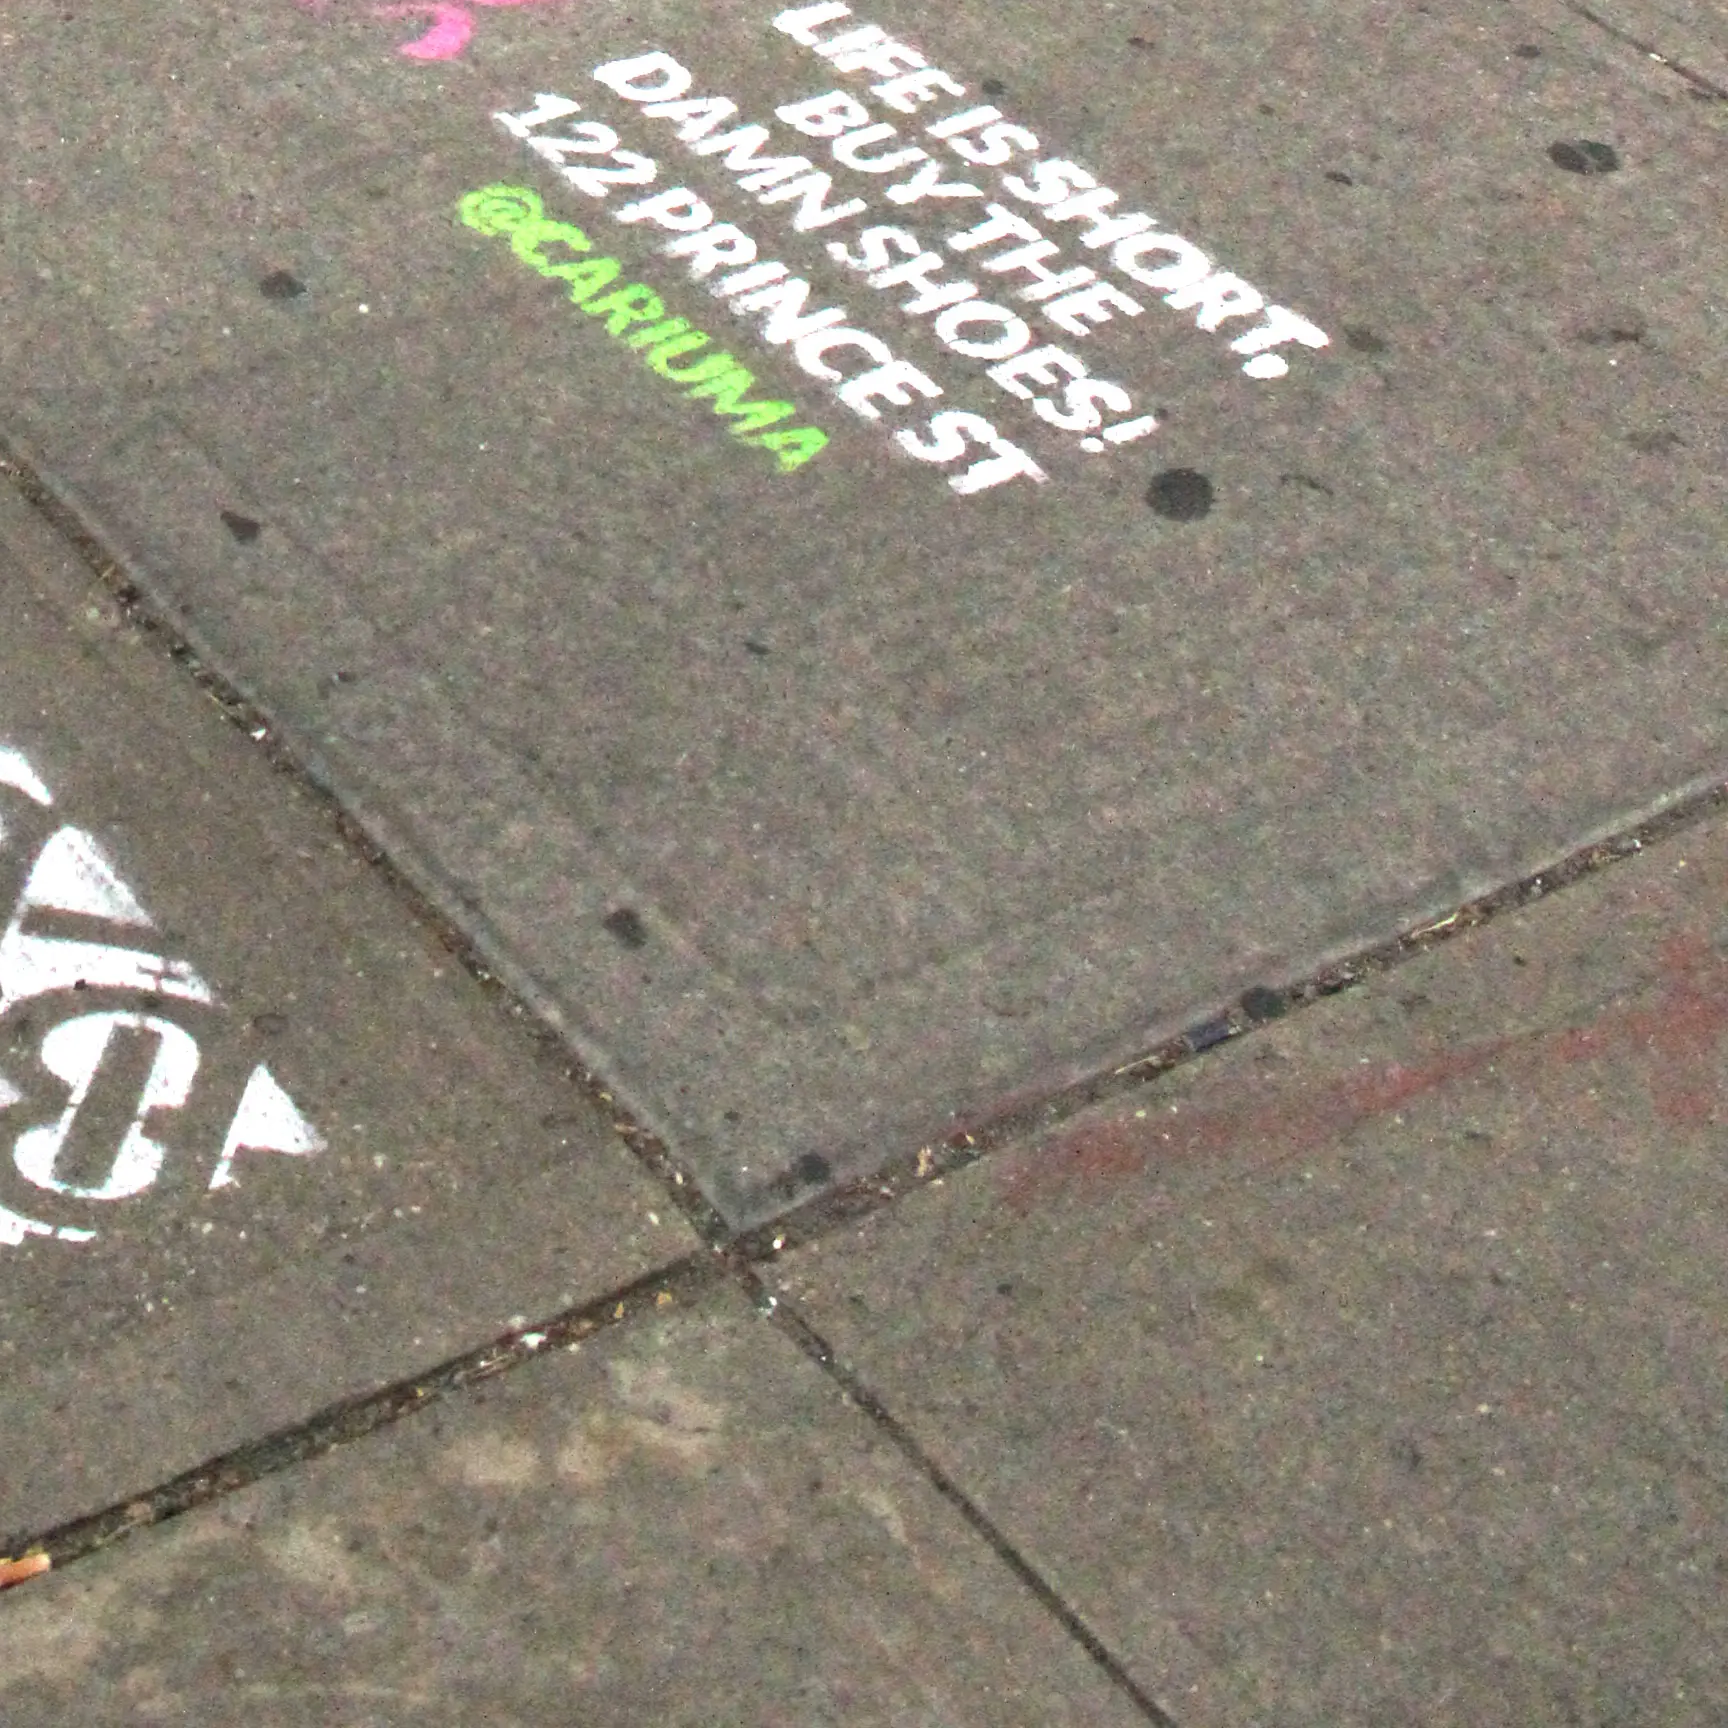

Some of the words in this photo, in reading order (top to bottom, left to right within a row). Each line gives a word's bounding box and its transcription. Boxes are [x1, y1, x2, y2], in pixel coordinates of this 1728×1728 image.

[771, 1, 966, 114] LIFE
[927, 105, 1040, 168] IS
[775, 89, 984, 206] BUY
[948, 203, 1146, 338] THE
[458, 182, 830, 473] @CARIUMA
[492, 91, 658, 198] 122
[613, 187, 945, 423] PRINCE
[895, 410, 1051, 496] ST
[593, 50, 866, 234] DAMN
[827, 223, 1159, 453] SHOES!
